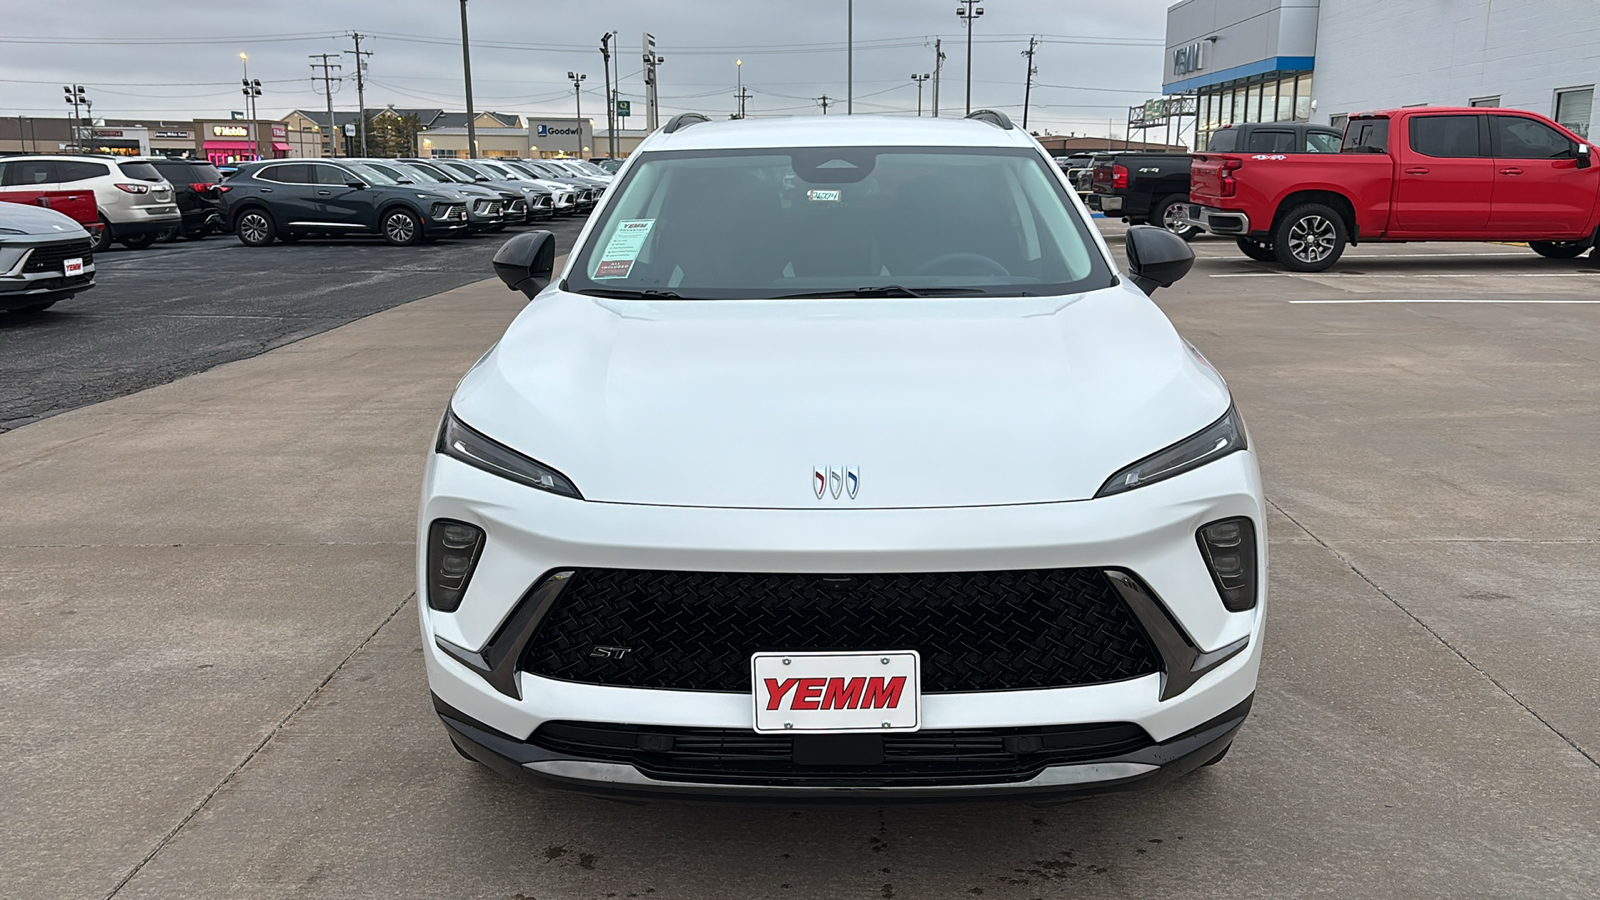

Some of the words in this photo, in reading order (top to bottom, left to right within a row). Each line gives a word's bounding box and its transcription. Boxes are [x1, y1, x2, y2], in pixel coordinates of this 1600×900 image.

[547, 127, 582, 135] Goodwil
[66, 263, 81, 271] YEMM
[590, 645, 632, 660] ST
[763, 676, 907, 711] YEMM
